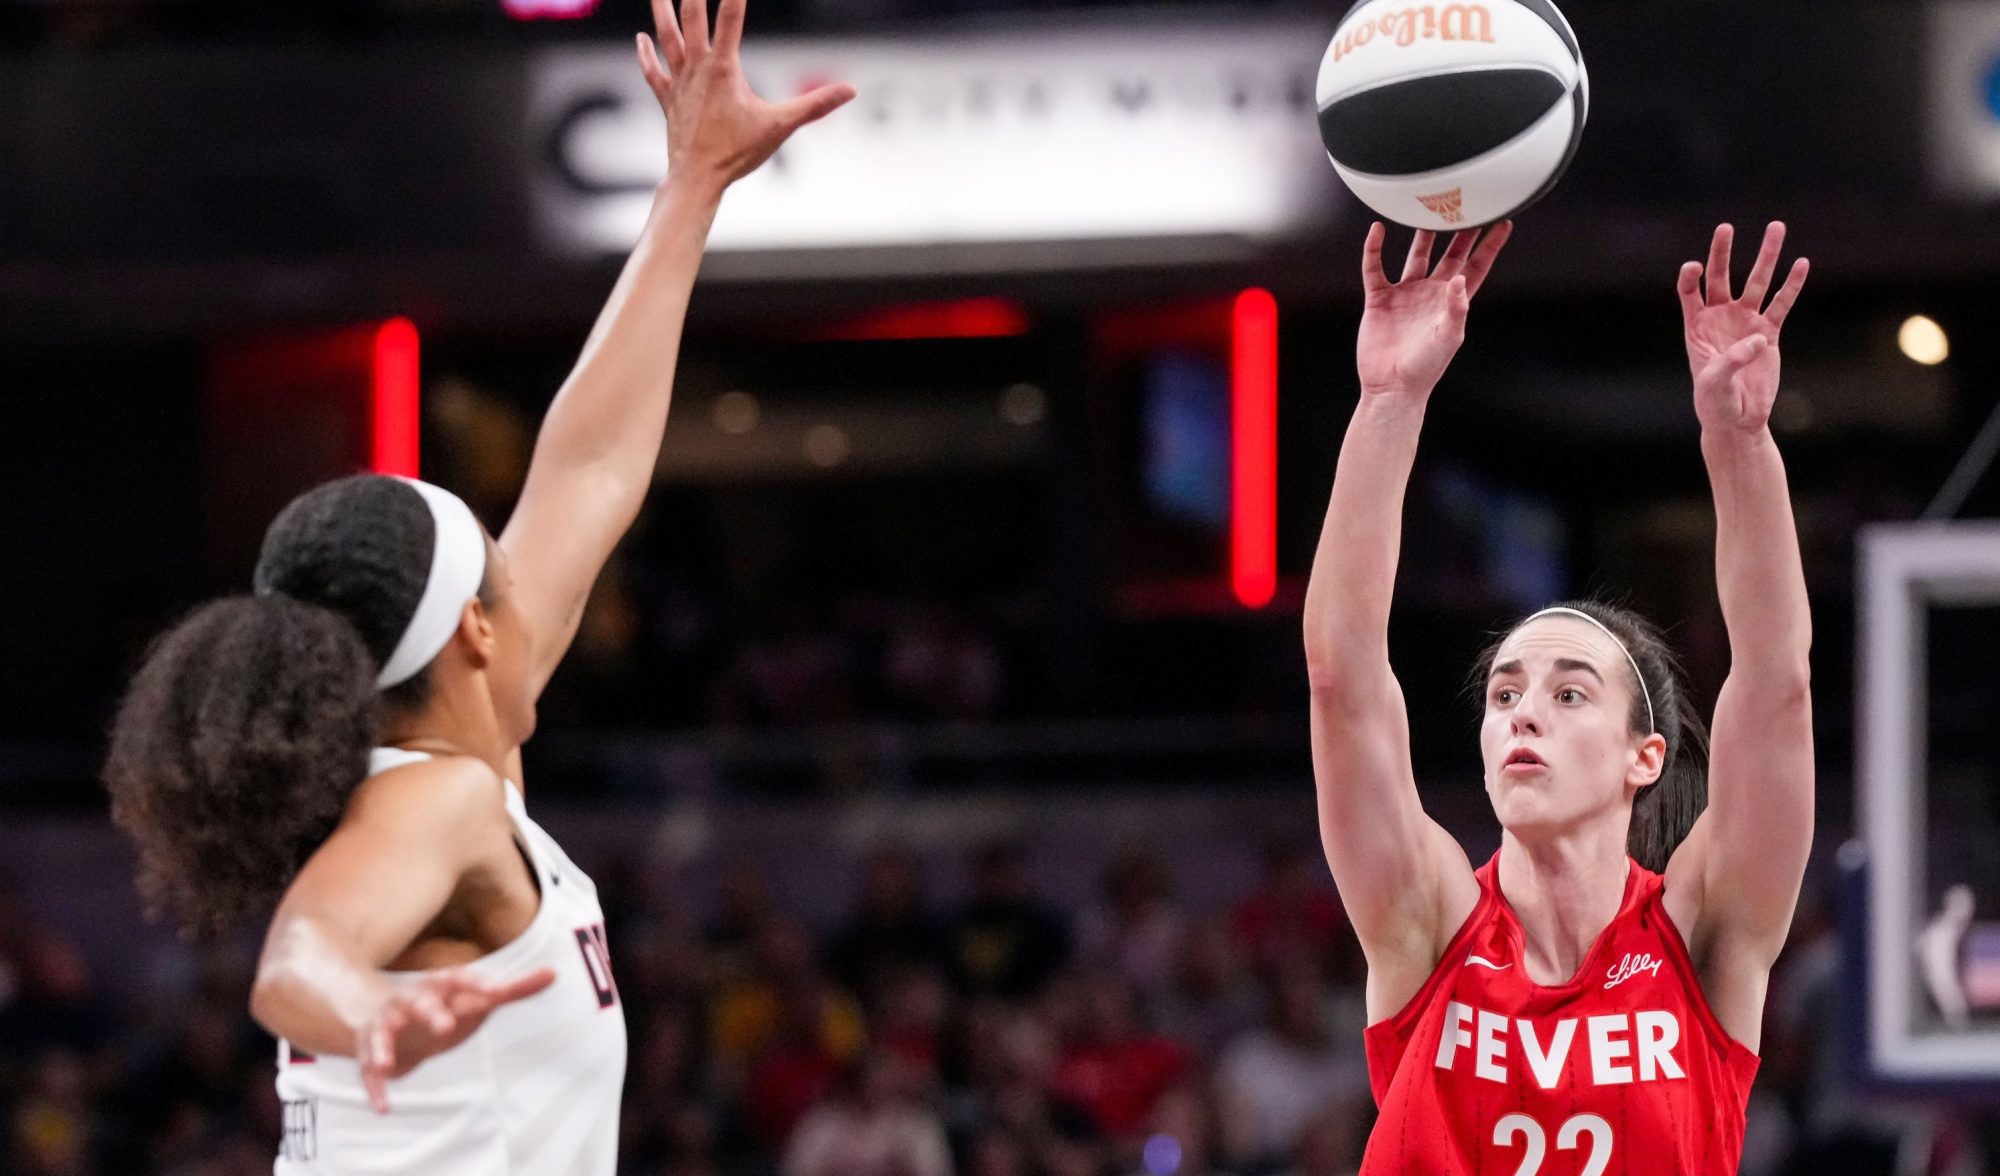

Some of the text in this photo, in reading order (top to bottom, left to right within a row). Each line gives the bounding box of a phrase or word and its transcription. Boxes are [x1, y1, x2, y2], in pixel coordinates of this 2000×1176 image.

[1333, 2, 1495, 63] Wilson
[1604, 953, 1662, 989] Lilly
[1435, 1000, 1687, 1089] FEVER
[1492, 1112, 1614, 1176] 22
